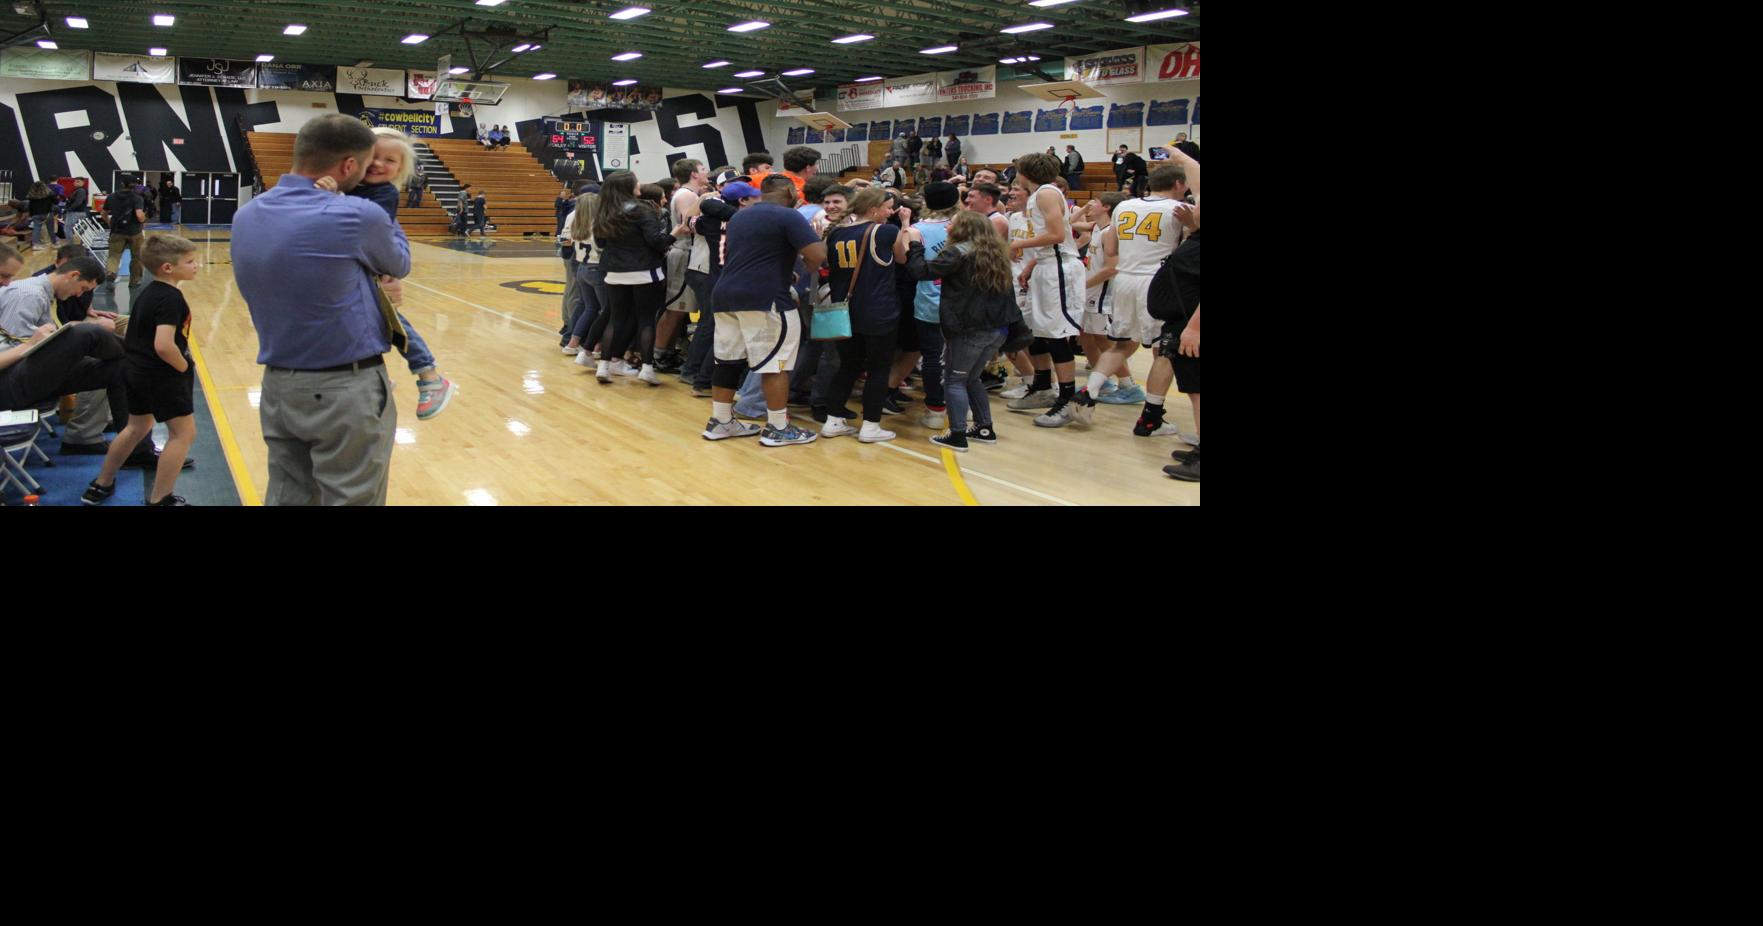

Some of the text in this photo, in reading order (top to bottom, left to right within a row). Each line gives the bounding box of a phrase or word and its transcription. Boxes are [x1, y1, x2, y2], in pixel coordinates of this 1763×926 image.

[302, 79, 332, 90] AXIA
[378, 111, 435, 125] #cowbellcity
[411, 125, 438, 134] SECTION
[552, 134, 565, 144] 64
[583, 136, 595, 145] 52
[1118, 211, 1163, 242] 24
[579, 242, 592, 263] 7
[835, 240, 858, 269] 11
